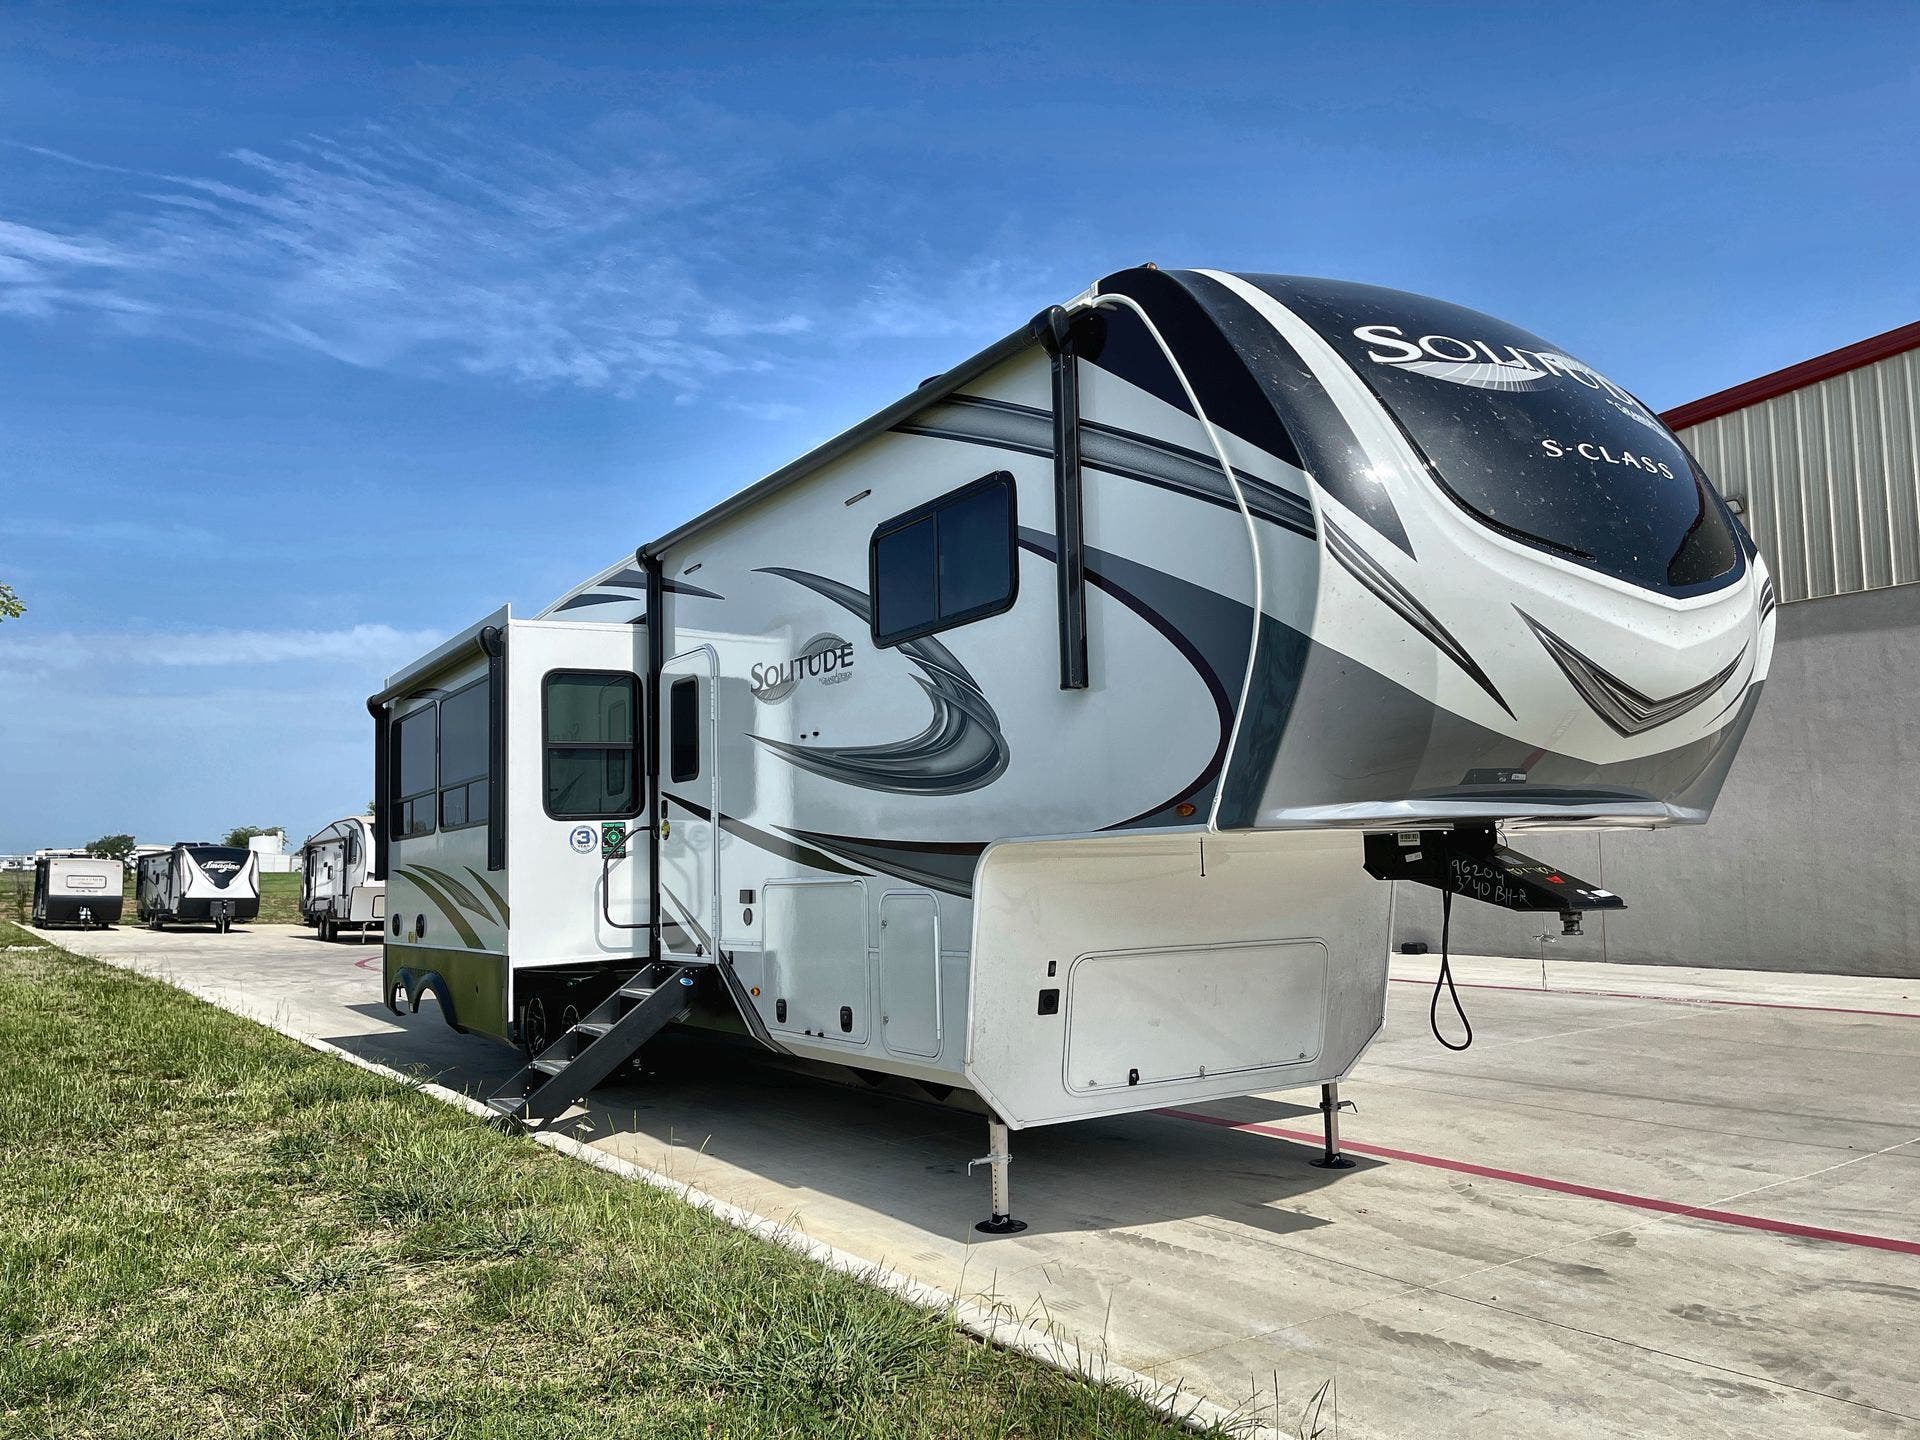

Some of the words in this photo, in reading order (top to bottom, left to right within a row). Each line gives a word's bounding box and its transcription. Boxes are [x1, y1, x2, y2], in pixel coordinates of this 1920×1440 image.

[1541, 439, 1674, 480] S-CLASS
[751, 642, 853, 692] SOLITUDE
[577, 830, 591, 844] 3
[201, 861, 241, 873] Imagine
[1452, 860, 1505, 888] 96204
[1456, 876, 1490, 899] 3740
